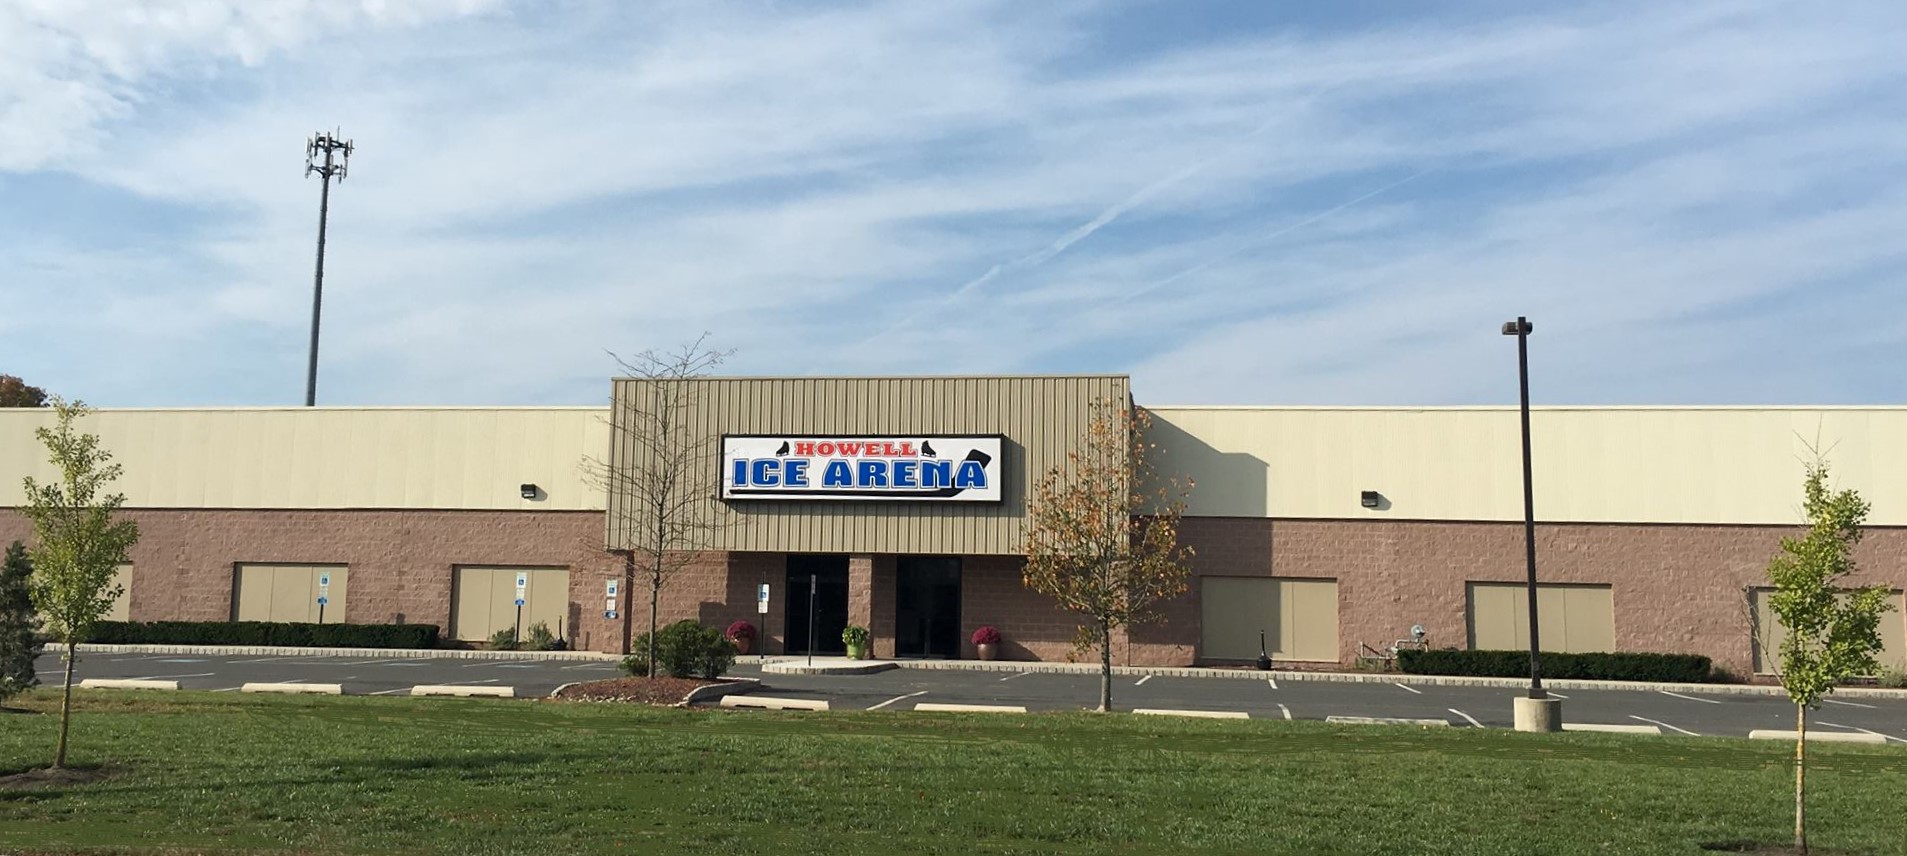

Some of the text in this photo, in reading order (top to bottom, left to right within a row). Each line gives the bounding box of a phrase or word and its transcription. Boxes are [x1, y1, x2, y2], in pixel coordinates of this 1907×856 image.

[794, 440, 918, 457] HOWELL
[732, 458, 988, 489] ICE ARENA
